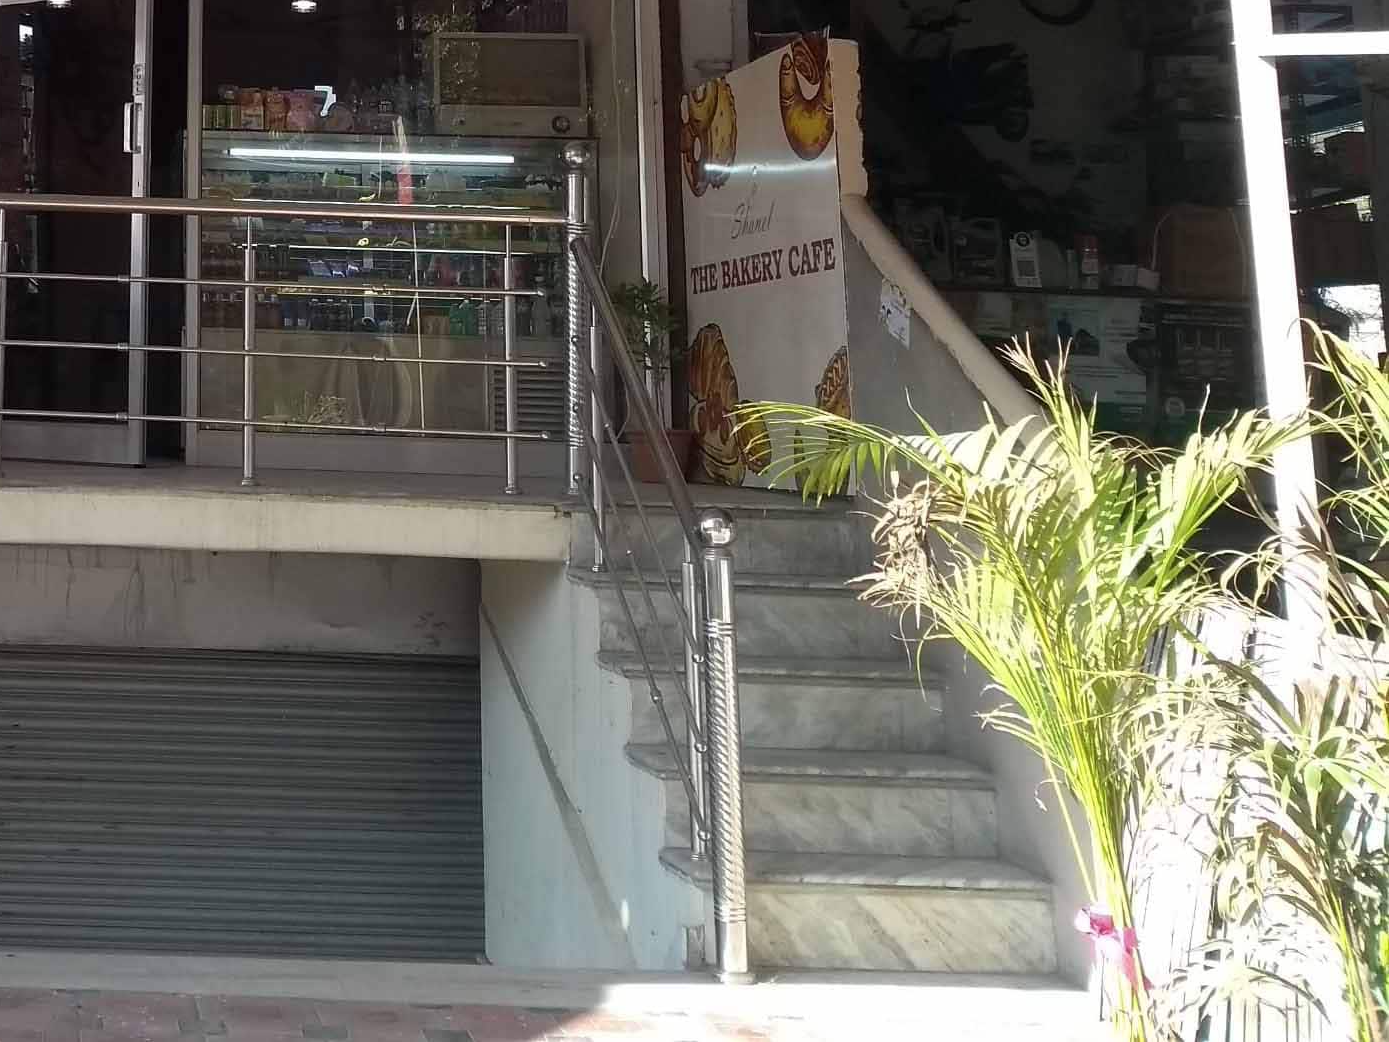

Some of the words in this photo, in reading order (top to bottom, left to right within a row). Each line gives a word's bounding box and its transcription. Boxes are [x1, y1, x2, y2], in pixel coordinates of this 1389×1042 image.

[690, 263, 718, 295] THE
[721, 249, 783, 290] BAKERY
[788, 238, 836, 278] CAFE
